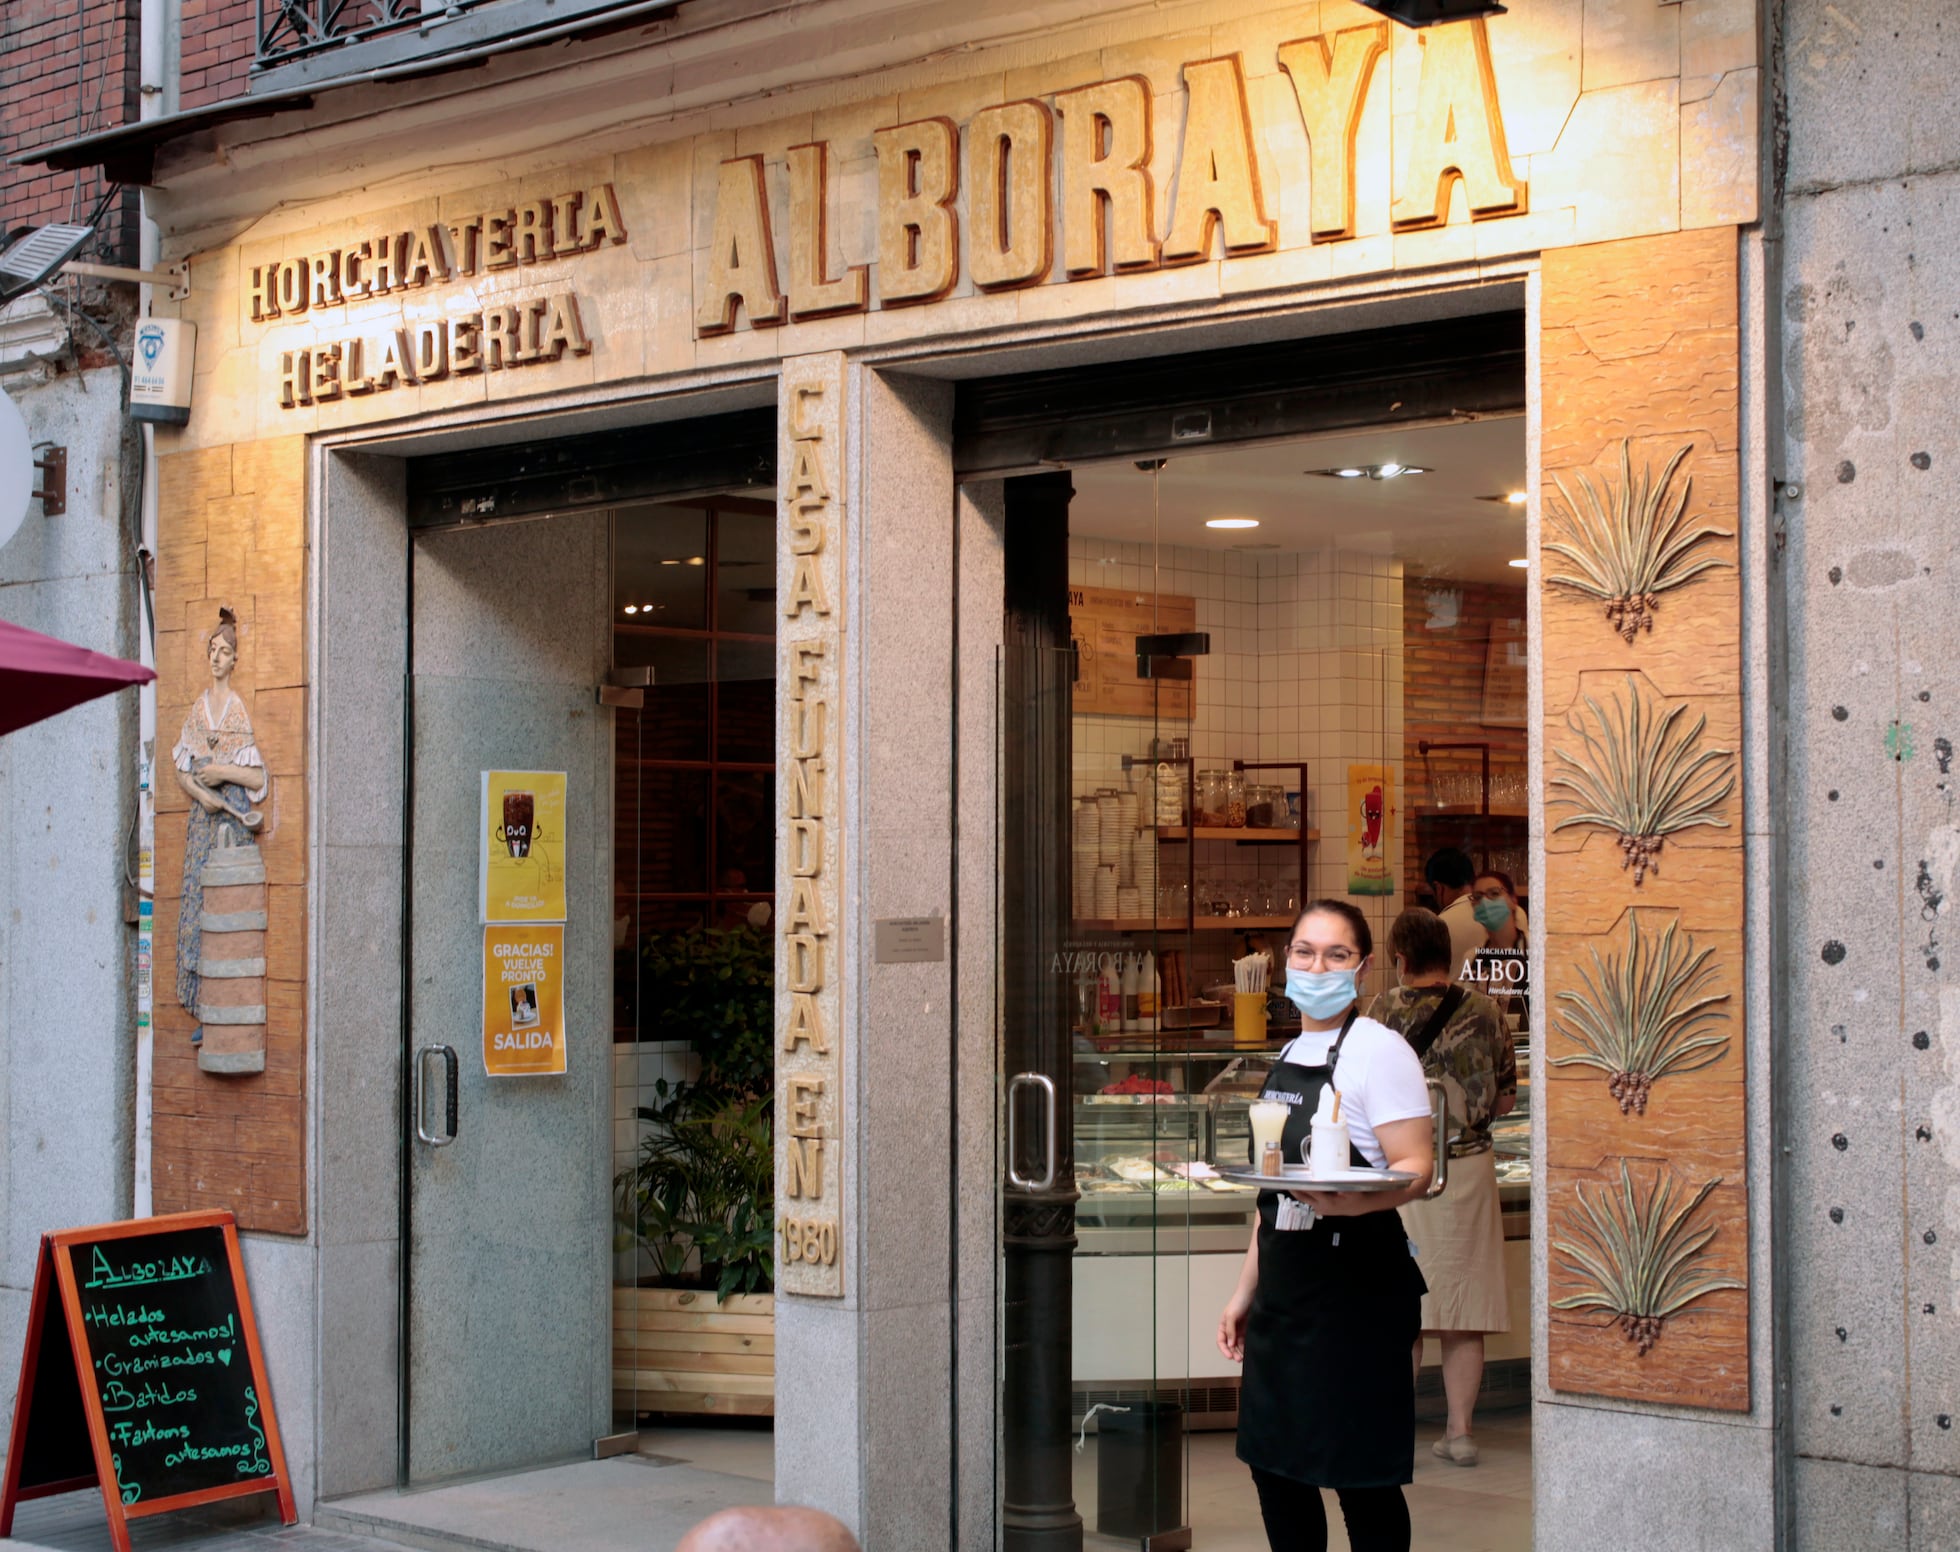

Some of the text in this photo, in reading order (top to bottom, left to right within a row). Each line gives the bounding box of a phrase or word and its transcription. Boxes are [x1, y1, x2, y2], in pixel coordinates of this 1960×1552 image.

[697, 19, 1528, 338] ALBORAYA
[249, 184, 627, 321] HORCHATERIA
[279, 293, 592, 408] HELADERIA
[778, 380, 838, 1265] CASA FUNDADA EN 1980
[493, 943, 553, 958] GRACIAS!
[503, 958, 544, 970] VUELVE
[501, 970, 546, 982] PRONTO
[494, 1031, 553, 1050] SALIDA
[92, 1303, 165, 1328] Helados
[104, 1380, 197, 1411] Batidos
